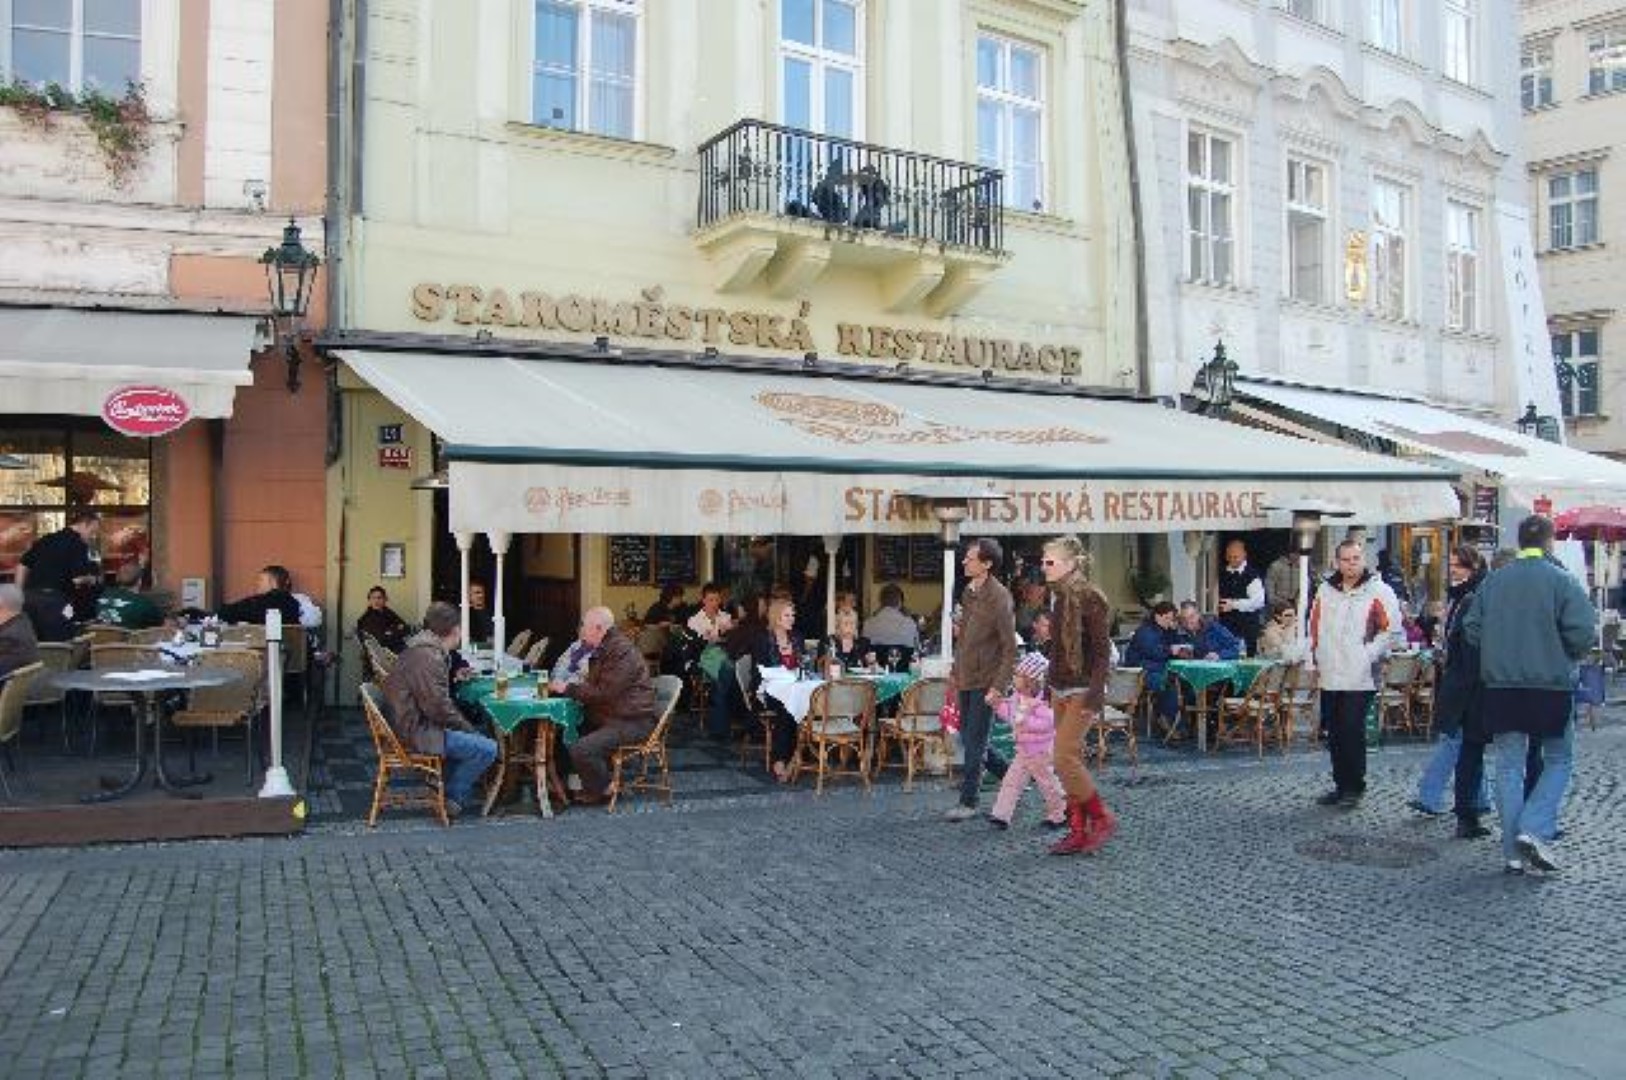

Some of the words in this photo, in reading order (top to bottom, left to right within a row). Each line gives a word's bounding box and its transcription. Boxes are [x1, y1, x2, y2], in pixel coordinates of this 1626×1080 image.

[412, 283, 816, 350] STAROMĚSTSKÁ
[837, 321, 1082, 376] RESTAURACE
[844, 481, 1095, 523] STARĚSTSKÁ
[1103, 491, 1267, 522] RESTAURACE
